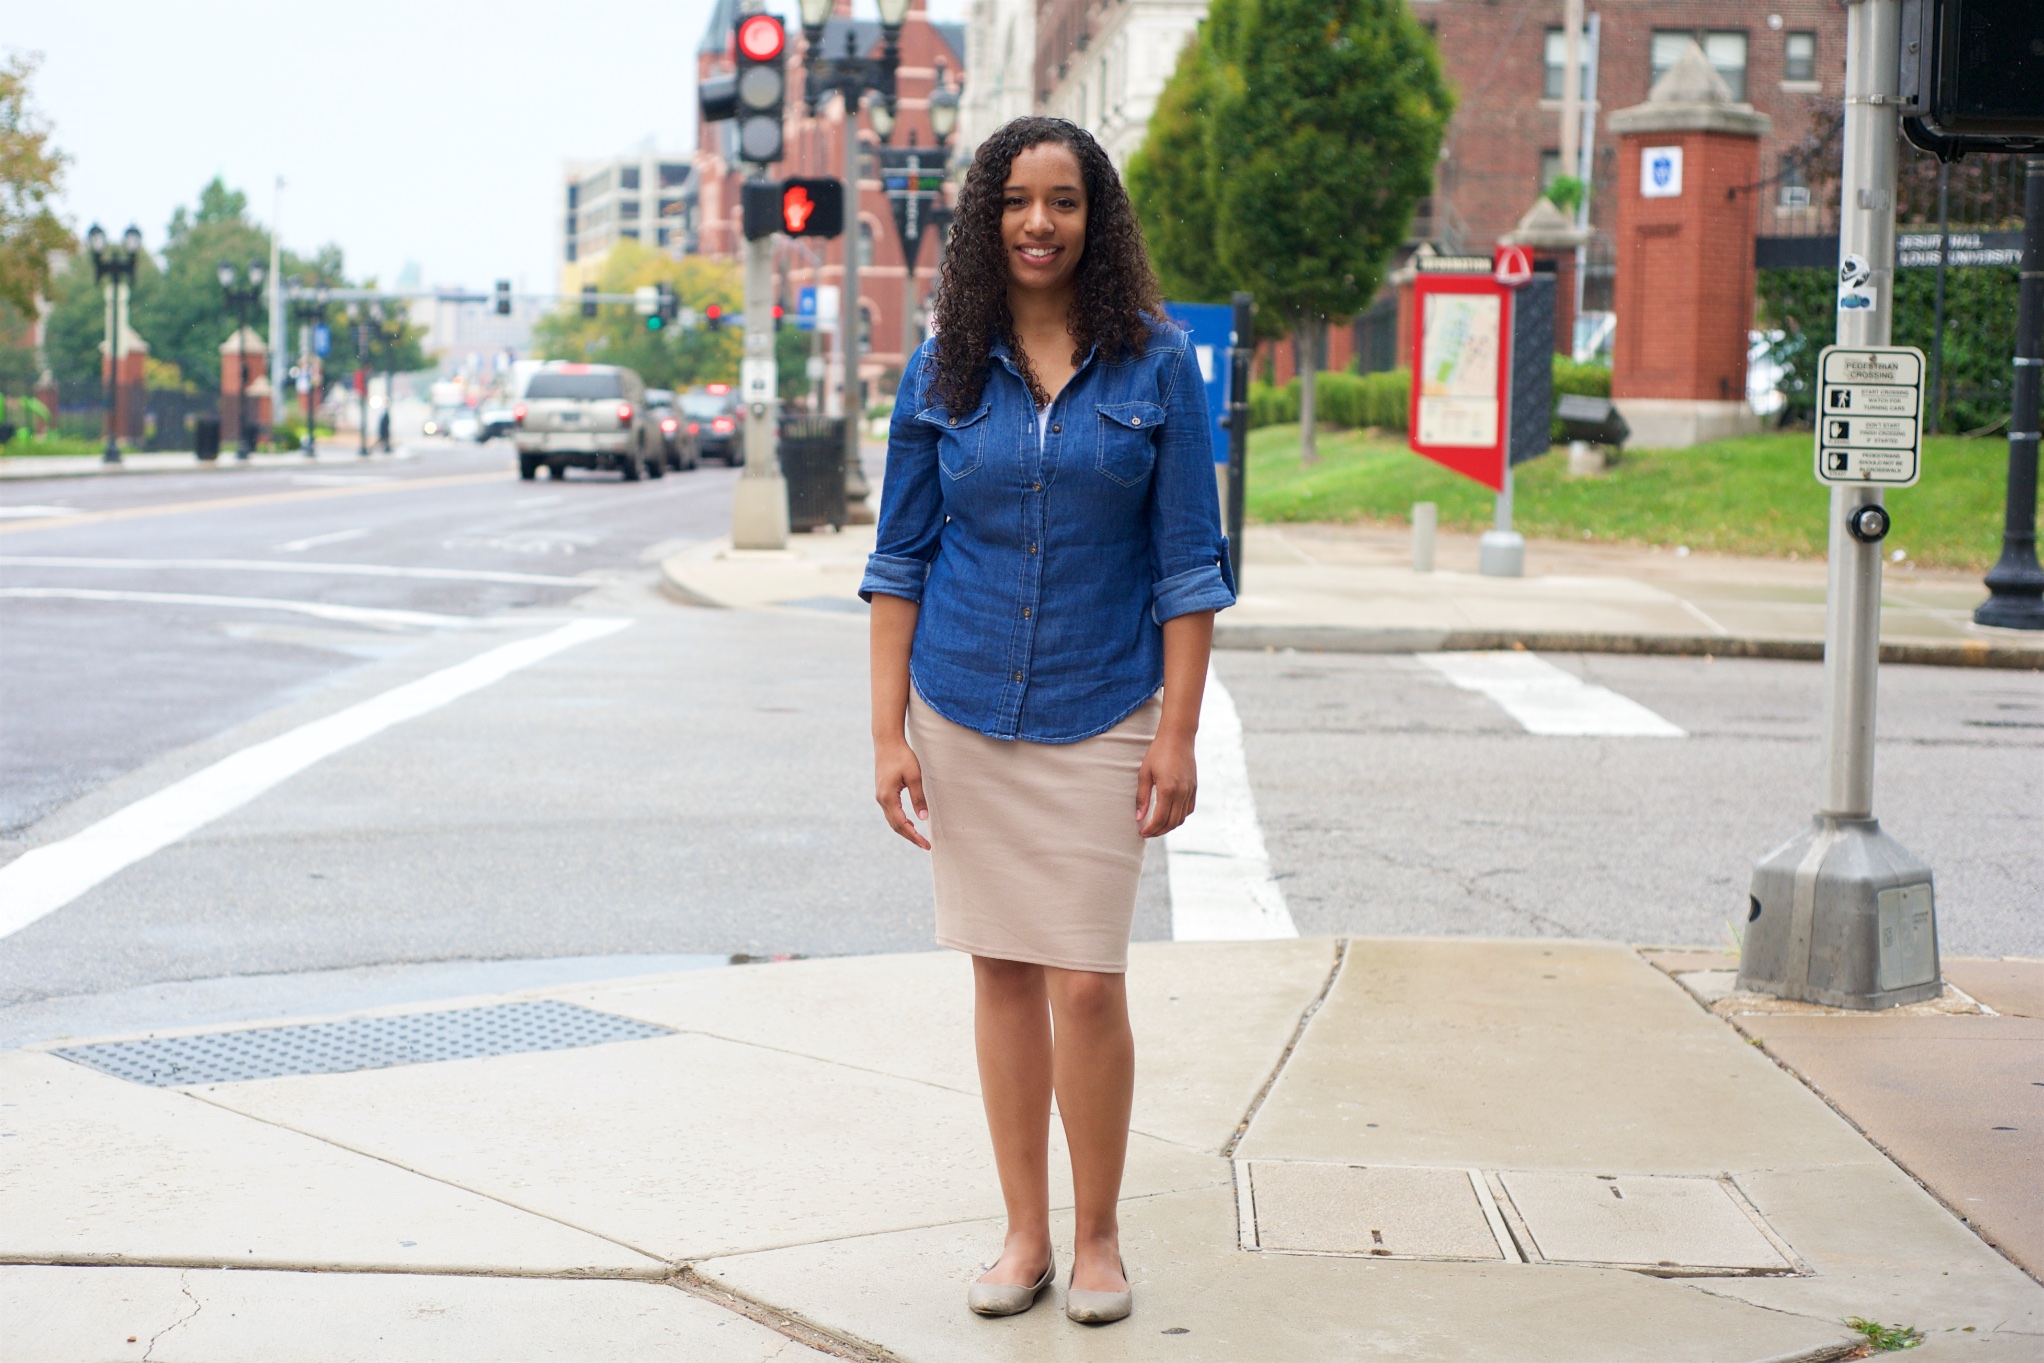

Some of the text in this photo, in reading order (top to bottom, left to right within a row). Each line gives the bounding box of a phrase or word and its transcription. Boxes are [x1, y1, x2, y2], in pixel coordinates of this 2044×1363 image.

[1900, 249, 2024, 267] LOUIS UNIVERSITY
[1846, 362, 1898, 370] PEDESTRIAN
[1850, 371, 1894, 379] CROSSING
